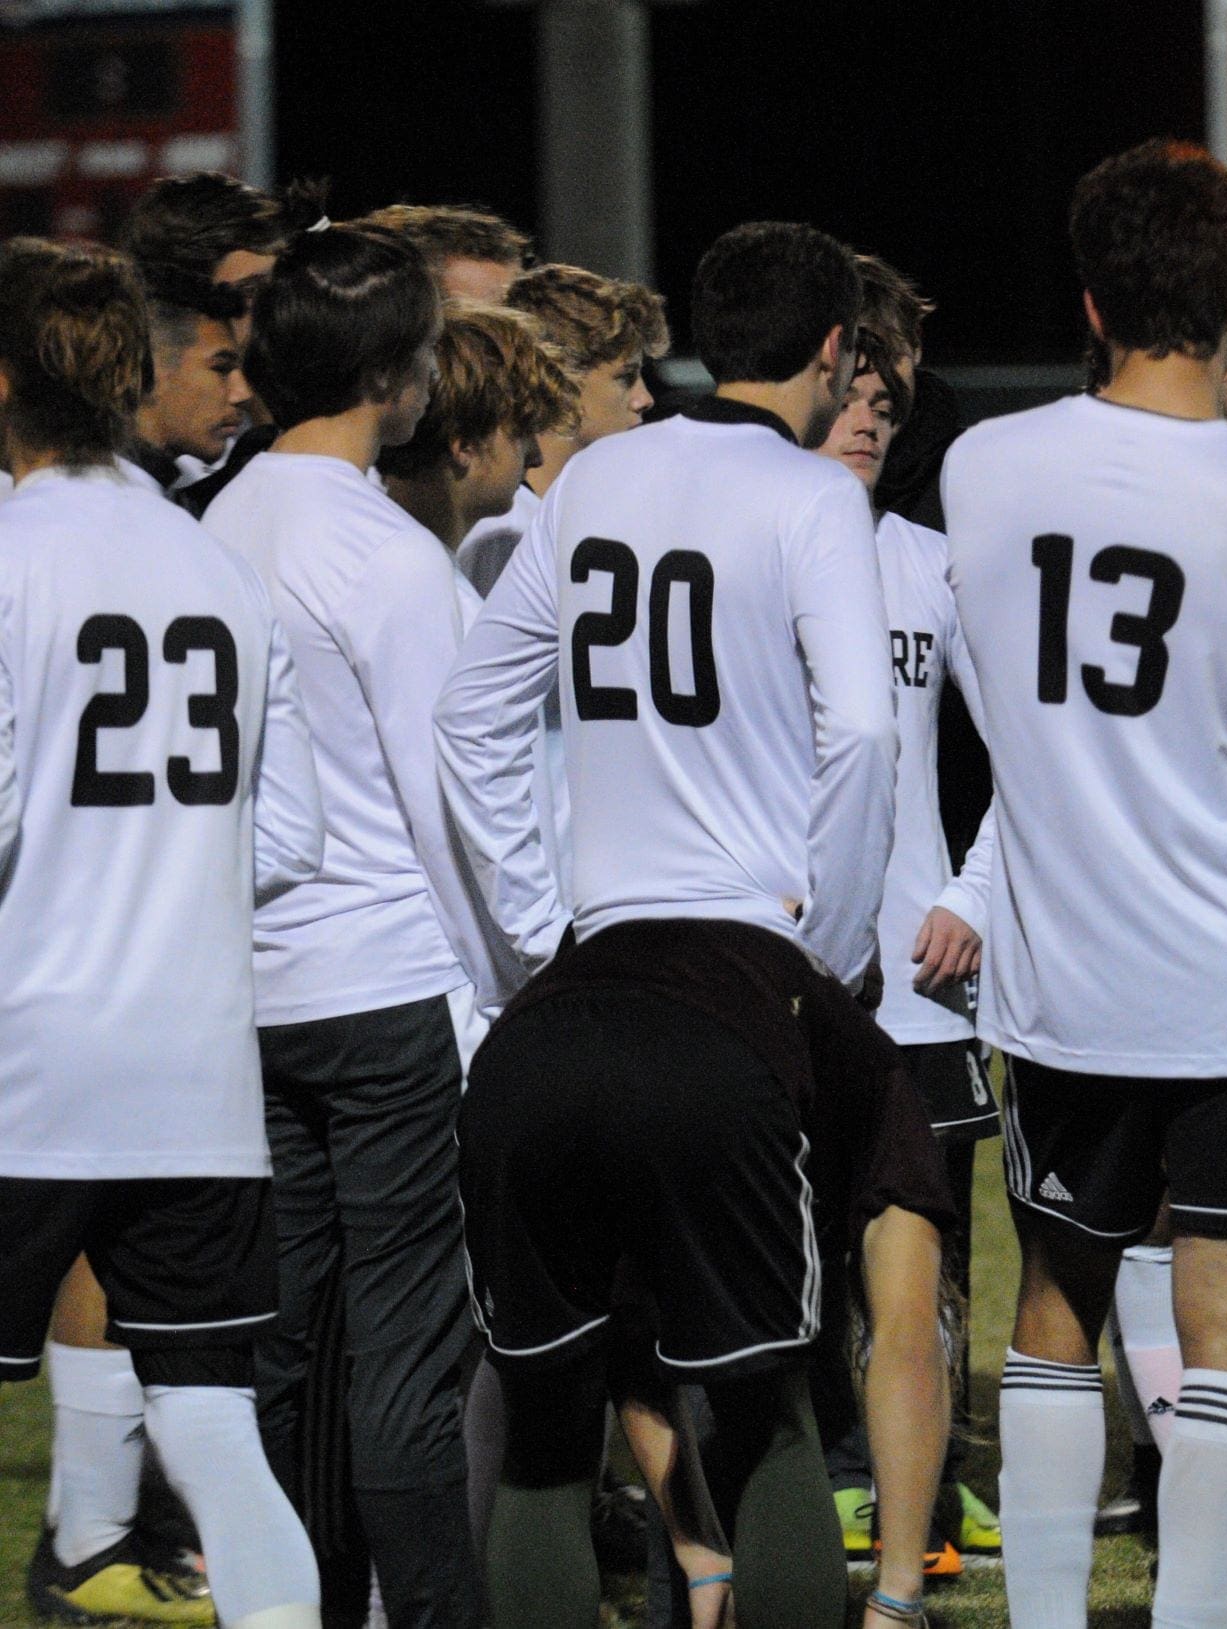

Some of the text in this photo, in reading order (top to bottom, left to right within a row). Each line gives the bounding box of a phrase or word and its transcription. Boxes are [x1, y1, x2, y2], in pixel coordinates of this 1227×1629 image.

[70, 614, 239, 807] 23
[570, 536, 721, 728] 20
[1031, 532, 1186, 717] 13
